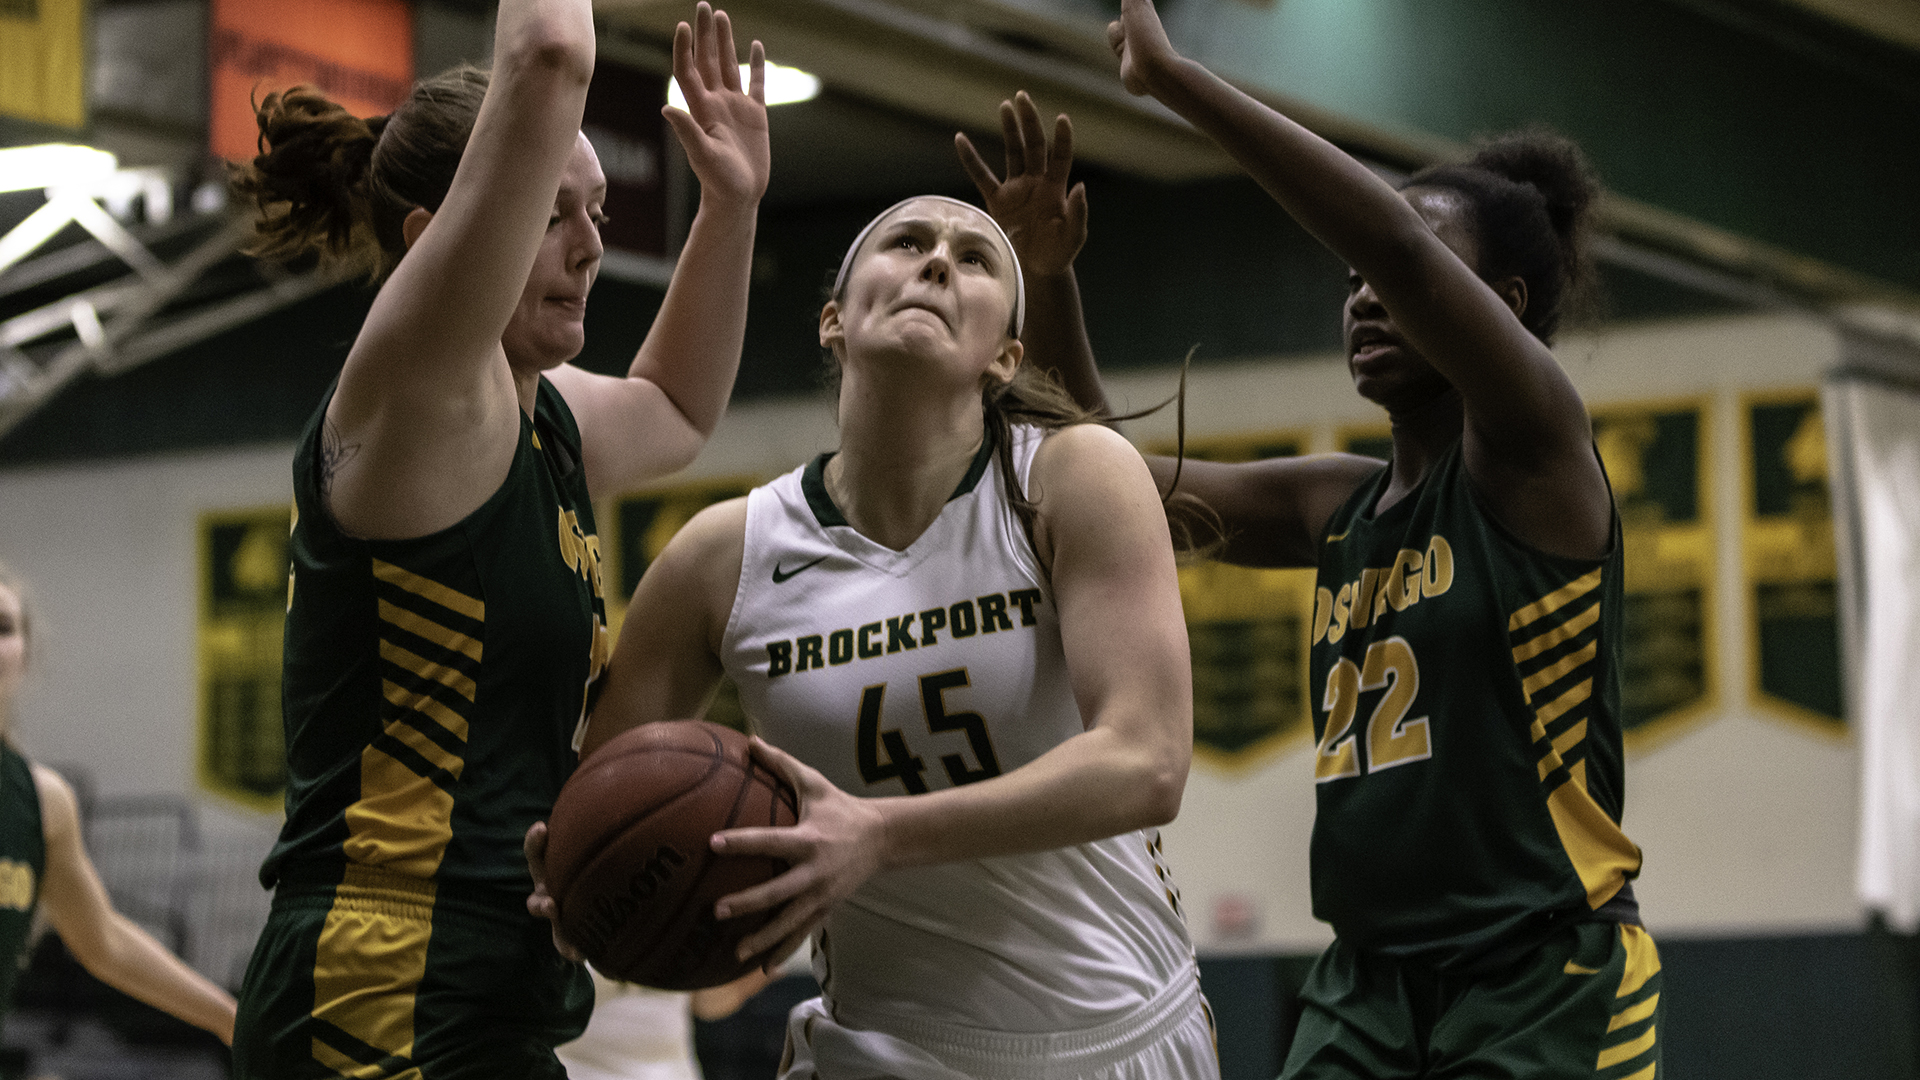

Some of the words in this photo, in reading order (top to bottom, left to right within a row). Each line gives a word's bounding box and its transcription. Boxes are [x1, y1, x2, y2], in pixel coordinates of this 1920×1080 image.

[766, 588, 1041, 678] BROCKPORT
[855, 667, 1001, 796] 45
[1315, 635, 1432, 784] 22
